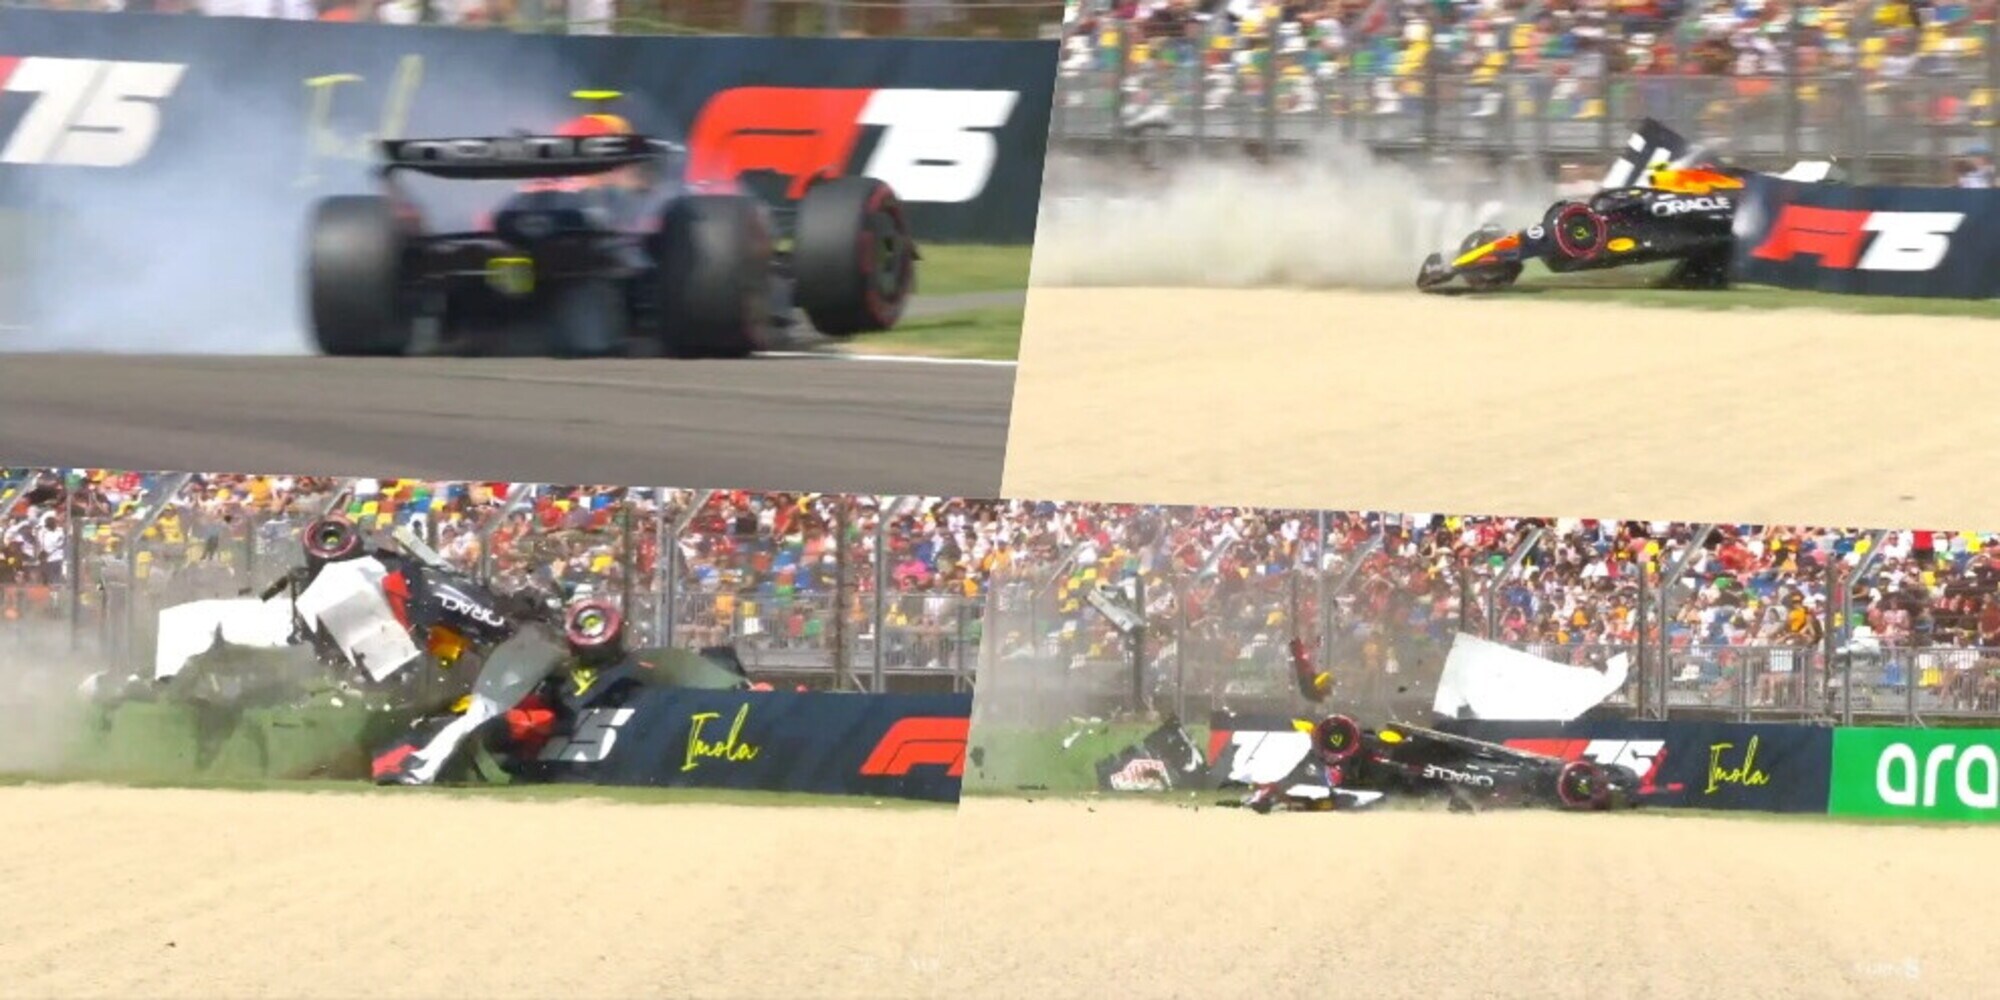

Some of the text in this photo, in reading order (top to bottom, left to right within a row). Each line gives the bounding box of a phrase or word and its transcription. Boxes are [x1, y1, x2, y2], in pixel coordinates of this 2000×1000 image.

[1652, 196, 1731, 217] ORACLE
[433, 591, 505, 627] ORACL
[680, 702, 759, 771] Imola
[1704, 734, 1770, 794] Imola
